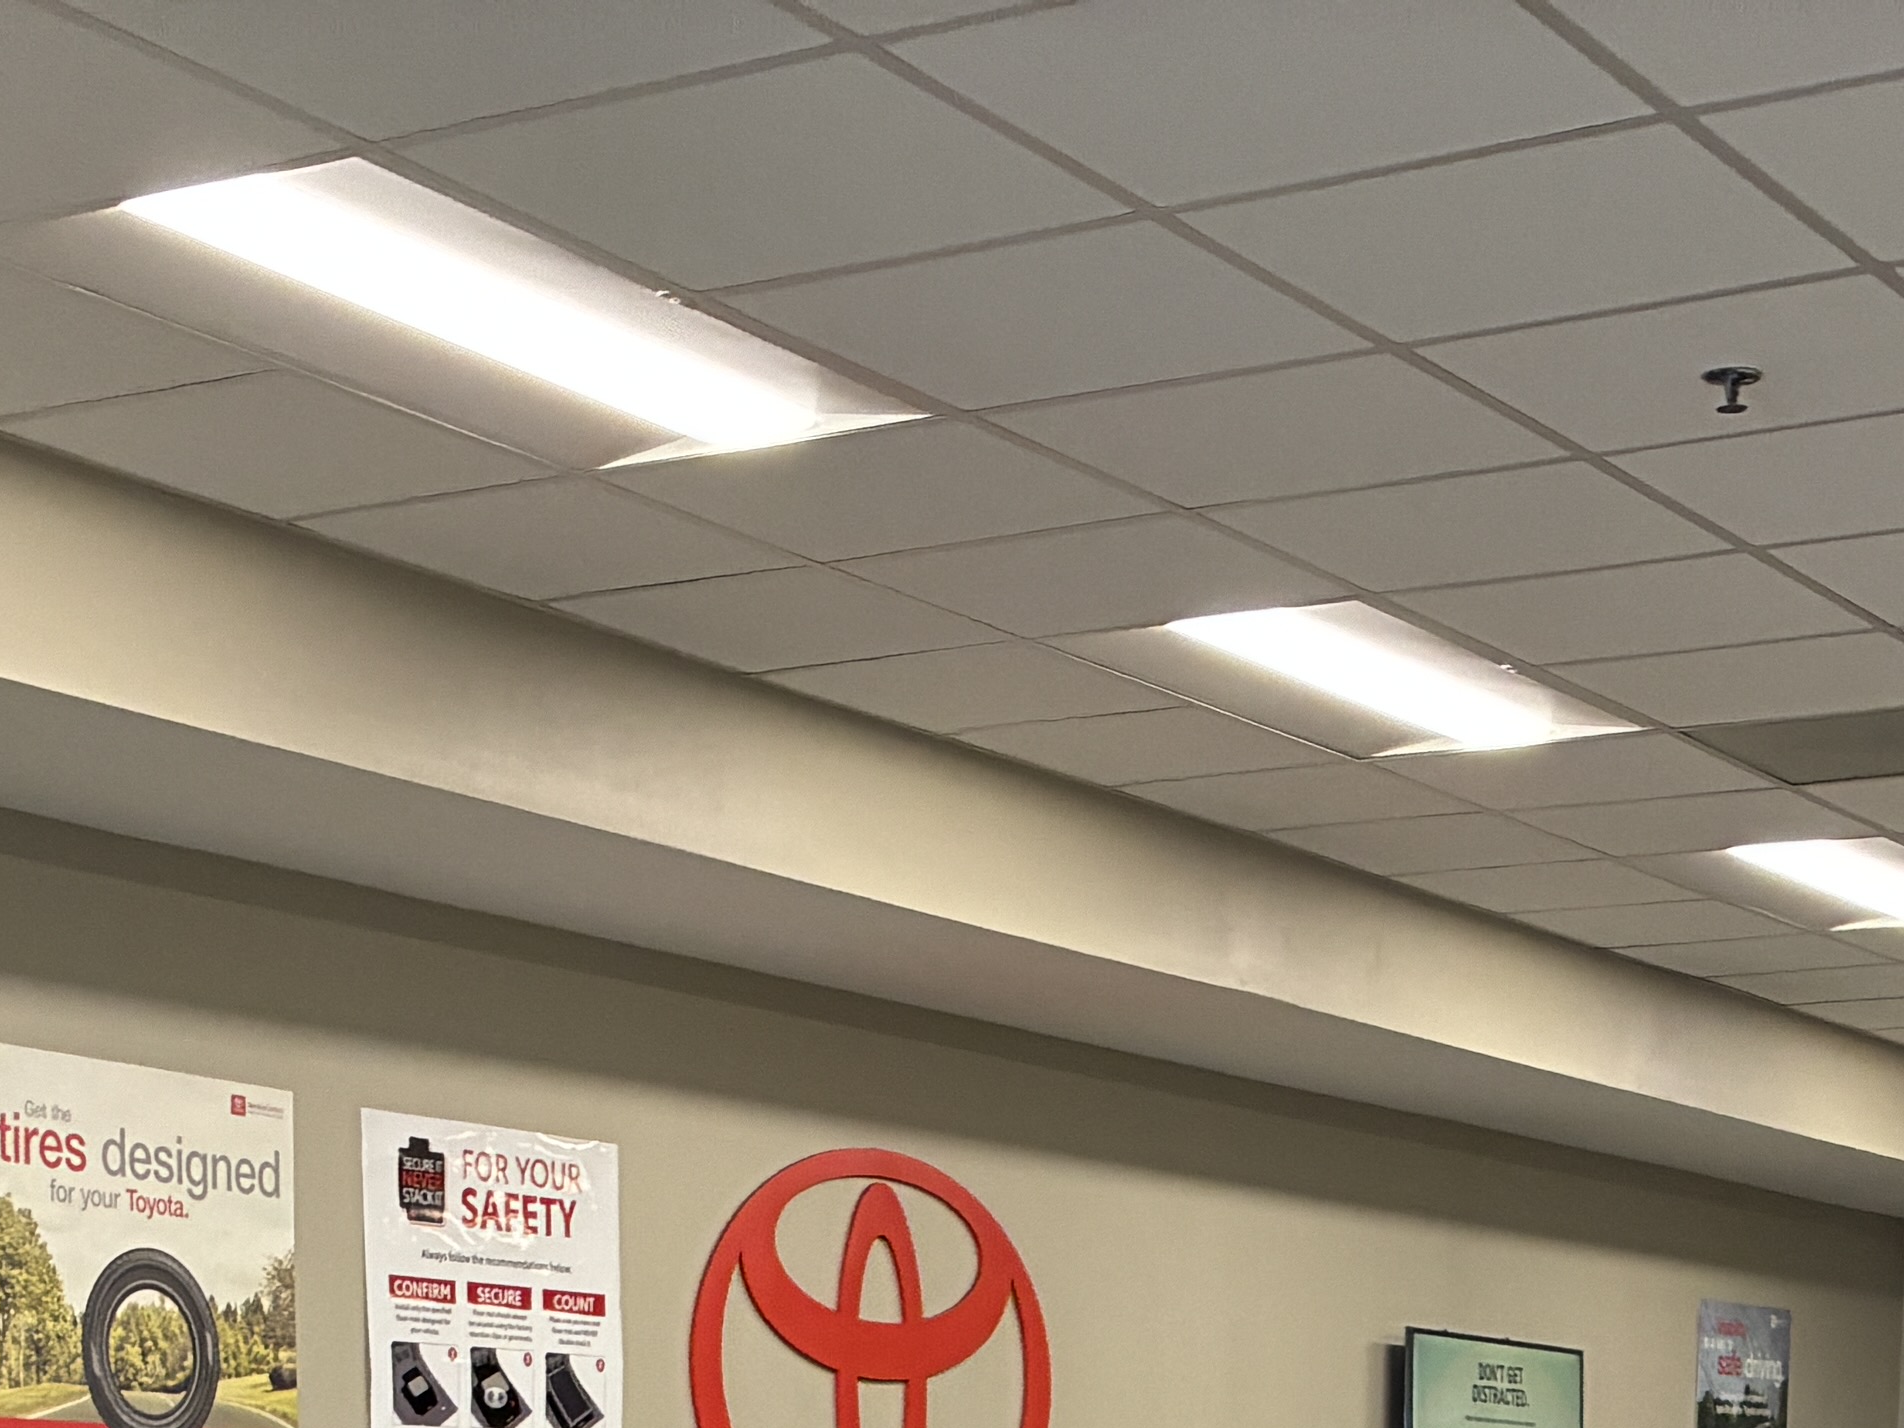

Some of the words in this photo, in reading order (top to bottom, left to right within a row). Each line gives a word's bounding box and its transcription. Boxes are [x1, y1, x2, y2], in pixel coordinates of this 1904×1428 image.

[25, 1100, 46, 1119] Get
[51, 1104, 72, 1122] the
[102, 1128, 281, 1201] designed
[403, 1157, 434, 1172] SECURE
[462, 1149, 509, 1185] FOR
[516, 1156, 583, 1193] YOUR
[403, 1171, 443, 1189] NEVER
[50, 1179, 75, 1203] for
[80, 1188, 121, 1211] your
[126, 1189, 189, 1219] Toyota.
[462, 1187, 577, 1238] SAFETY
[394, 1279, 451, 1300] CONFIRM
[476, 1286, 522, 1306] SECURE
[553, 1294, 595, 1312] COUNT
[1478, 1362, 1505, 1381] DON'T
[1507, 1366, 1523, 1384] GET
[1472, 1384, 1530, 1407] DISTRACTED.
